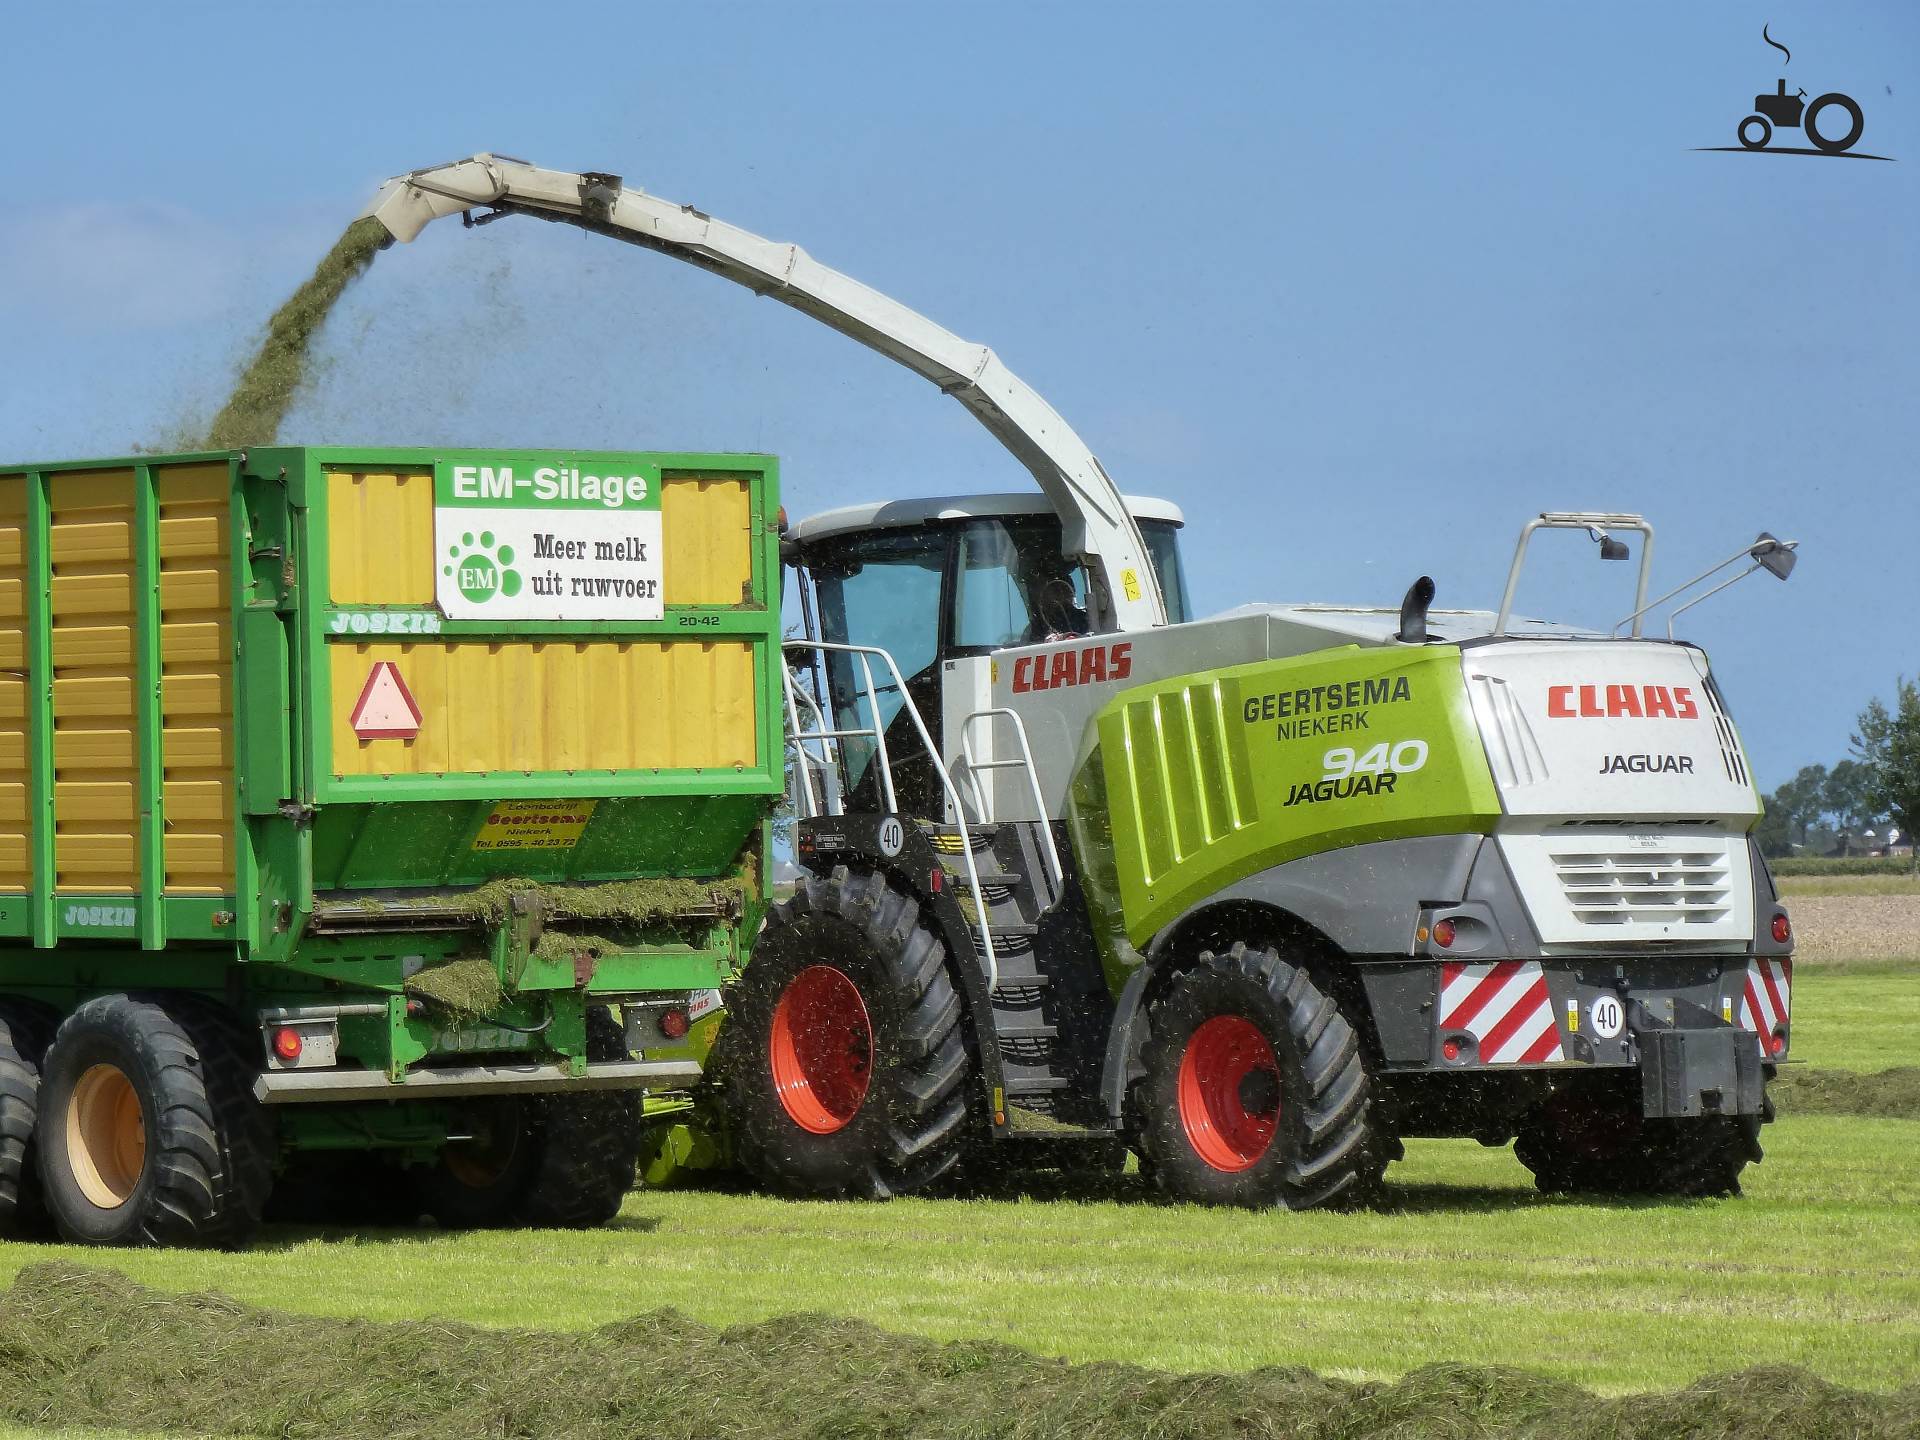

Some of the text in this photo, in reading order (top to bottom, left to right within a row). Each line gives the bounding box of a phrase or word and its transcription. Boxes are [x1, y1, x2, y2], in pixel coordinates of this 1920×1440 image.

[454, 466, 647, 507] EM-Silage
[533, 533, 647, 562] Meer melk
[461, 568, 495, 590] EM
[532, 570, 657, 598] uit ruwvoer
[331, 613, 441, 634] JOSKIN
[679, 616, 720, 626] 20-42
[1012, 642, 1133, 694] CLAAS
[1244, 676, 1411, 723] GEERTSEMA
[1548, 685, 1699, 719] CLAAS
[1277, 710, 1370, 741] NIEKERK
[1322, 739, 1429, 782] 940
[1600, 754, 1694, 774] JAGUAR
[1283, 773, 1398, 807] JAGUAR
[883, 824, 899, 849] 40
[65, 905, 137, 927] JOSKIN
[1597, 1003, 1617, 1030] 40
